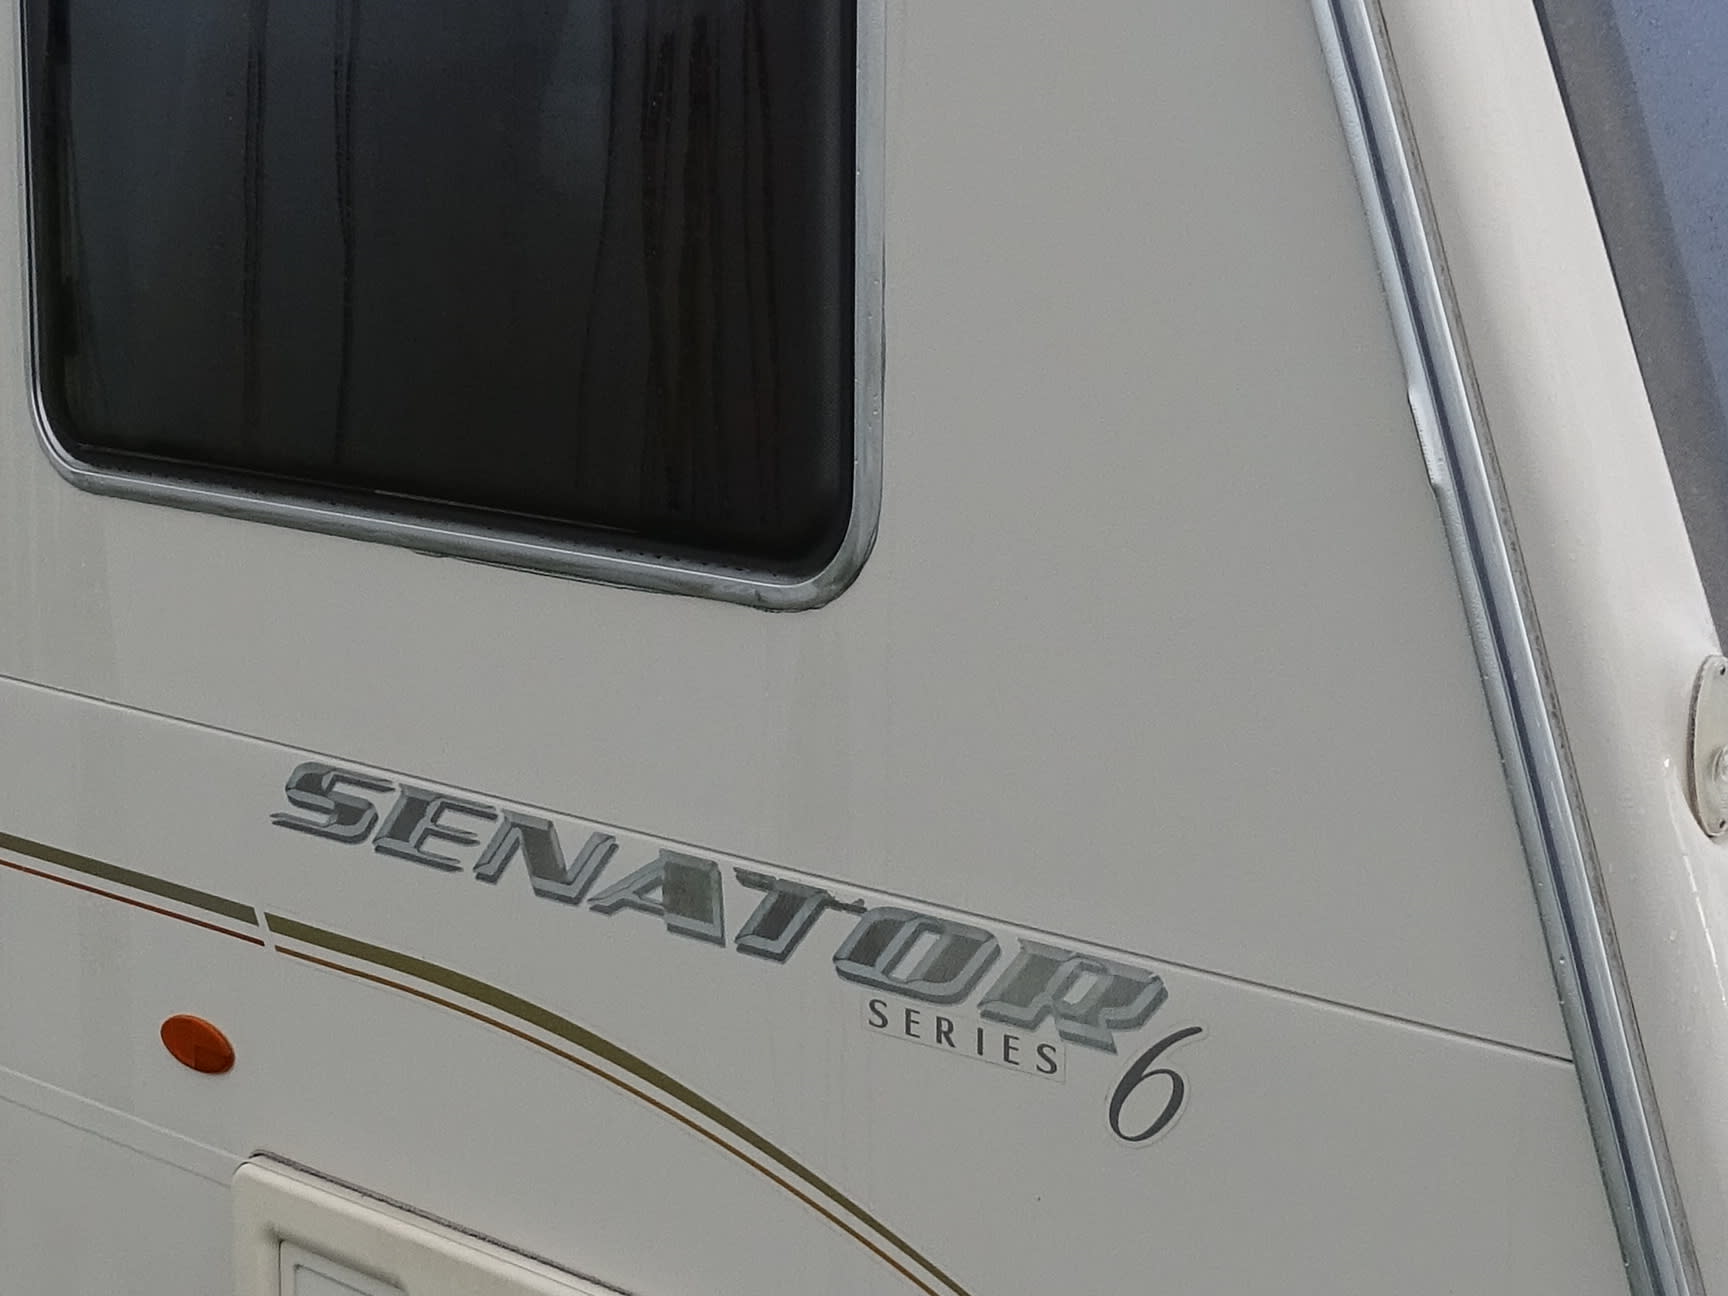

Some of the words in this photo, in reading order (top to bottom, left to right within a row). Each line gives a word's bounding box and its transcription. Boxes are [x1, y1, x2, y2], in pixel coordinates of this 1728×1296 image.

[271, 760, 1169, 1055] SENATOR
[867, 998, 1059, 1076] SERIES
[1108, 1025, 1203, 1143] 6
